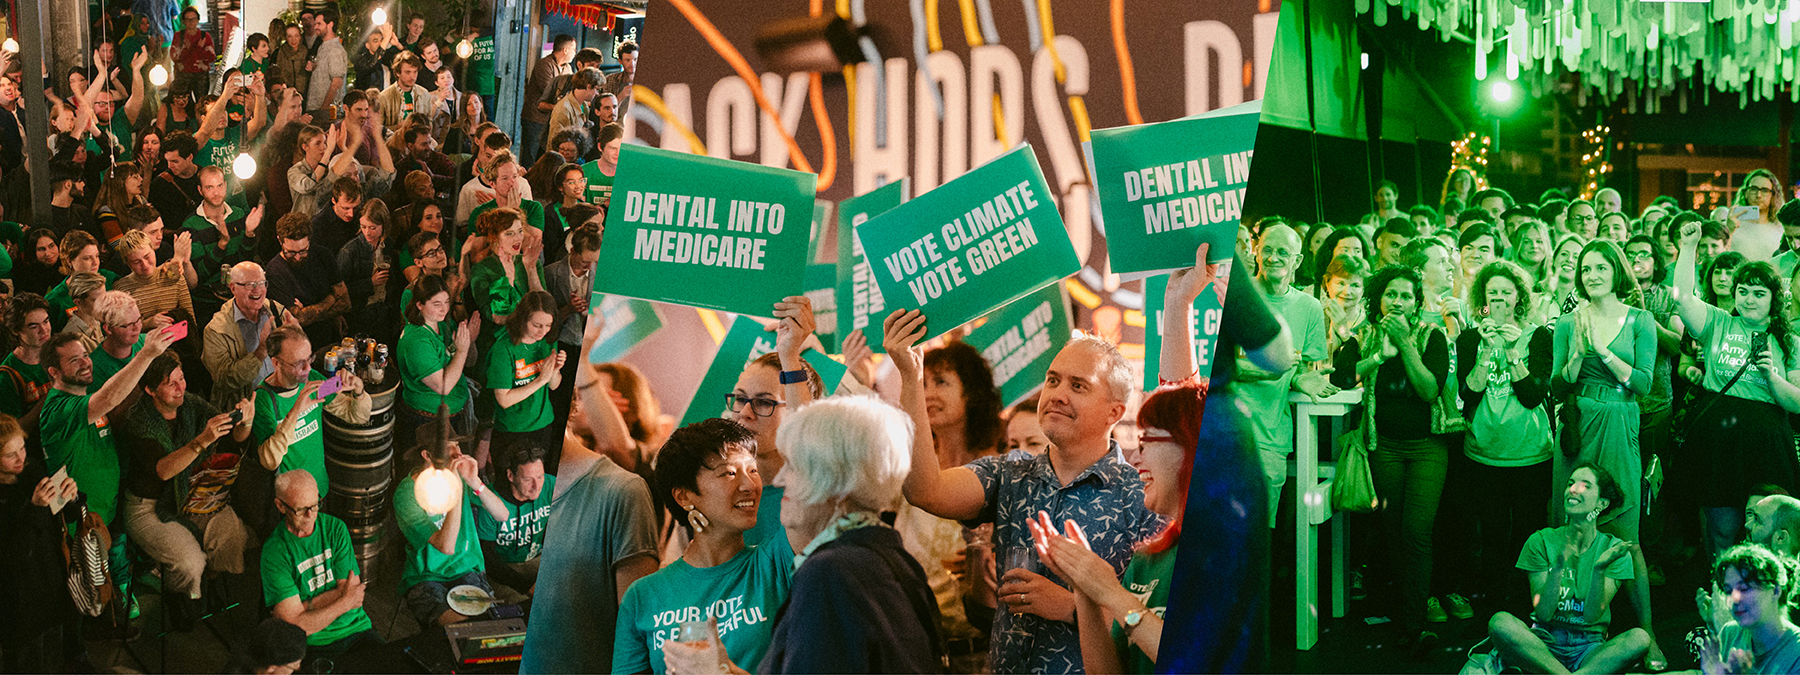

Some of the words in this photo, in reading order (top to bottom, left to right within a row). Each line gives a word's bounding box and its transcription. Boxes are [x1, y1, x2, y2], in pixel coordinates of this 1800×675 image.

[1124, 158, 1219, 202] DENTAL
[1203, 150, 1254, 186] IN
[623, 190, 720, 229] DENTAL
[727, 199, 786, 235] INTO
[883, 232, 943, 283] VOTE
[941, 179, 1039, 252] CLIMATE
[1143, 188, 1246, 235] MEDICA
[633, 228, 767, 270] MEDICARE
[908, 256, 967, 307] VOTE
[966, 217, 1039, 276] GREEN
[1021, 300, 1053, 339] INTO
[1722, 342, 1747, 357] Amy
[501, 521, 508, 532] A
[509, 505, 551, 530] FUTURE
[653, 606, 701, 627] YOUR
[705, 594, 743, 619] VOTE
[653, 629, 666, 650] IS
[670, 606, 767, 642] PERFUL
